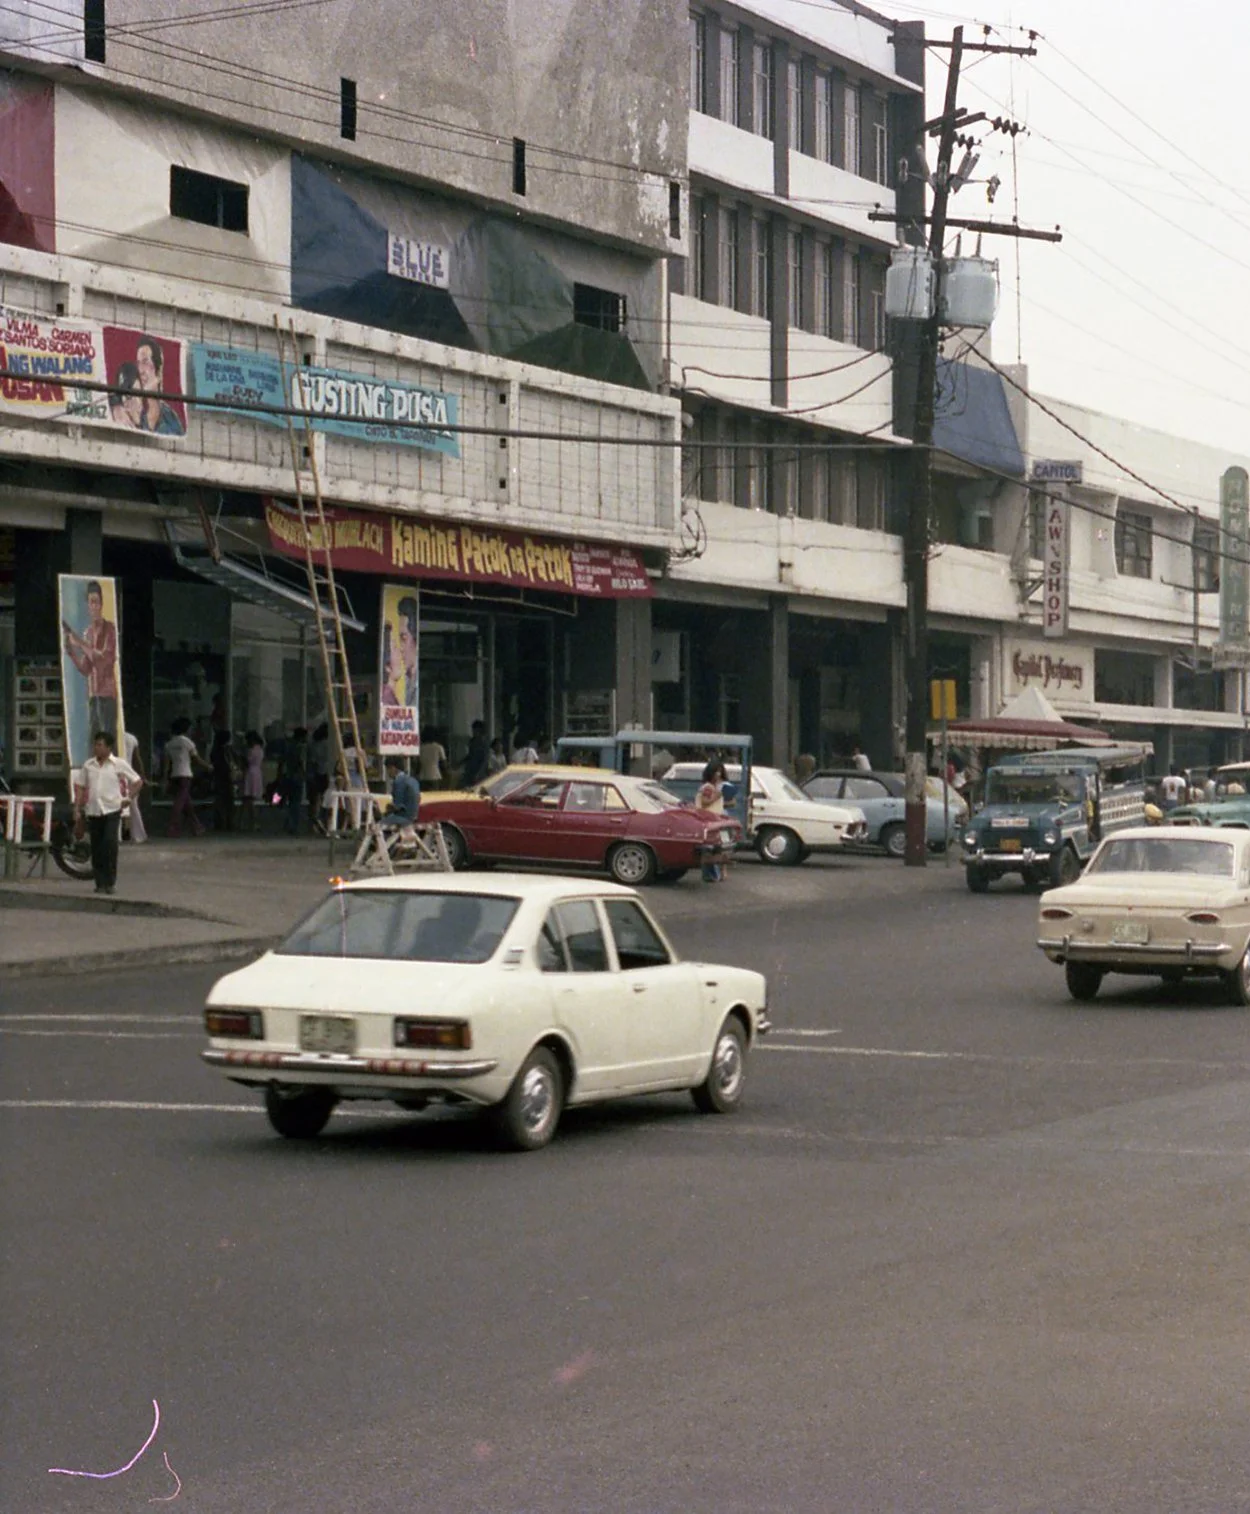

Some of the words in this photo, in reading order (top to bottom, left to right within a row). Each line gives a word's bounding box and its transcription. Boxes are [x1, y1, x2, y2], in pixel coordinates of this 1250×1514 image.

[392, 241, 444, 278] BLUE
[7, 318, 39, 336] VILMA
[51, 327, 92, 345] CARMEN
[4, 331, 47, 351] SANTOS
[48, 340, 95, 360] SORIANO
[8, 353, 29, 375] NG
[31, 355, 93, 375] WALANG
[291, 372, 387, 418] GUSTING
[390, 388, 453, 437] PUSA
[1034, 464, 1078, 480] CAPITOL
[461, 527, 513, 579] Patok
[524, 536, 574, 588] Patok
